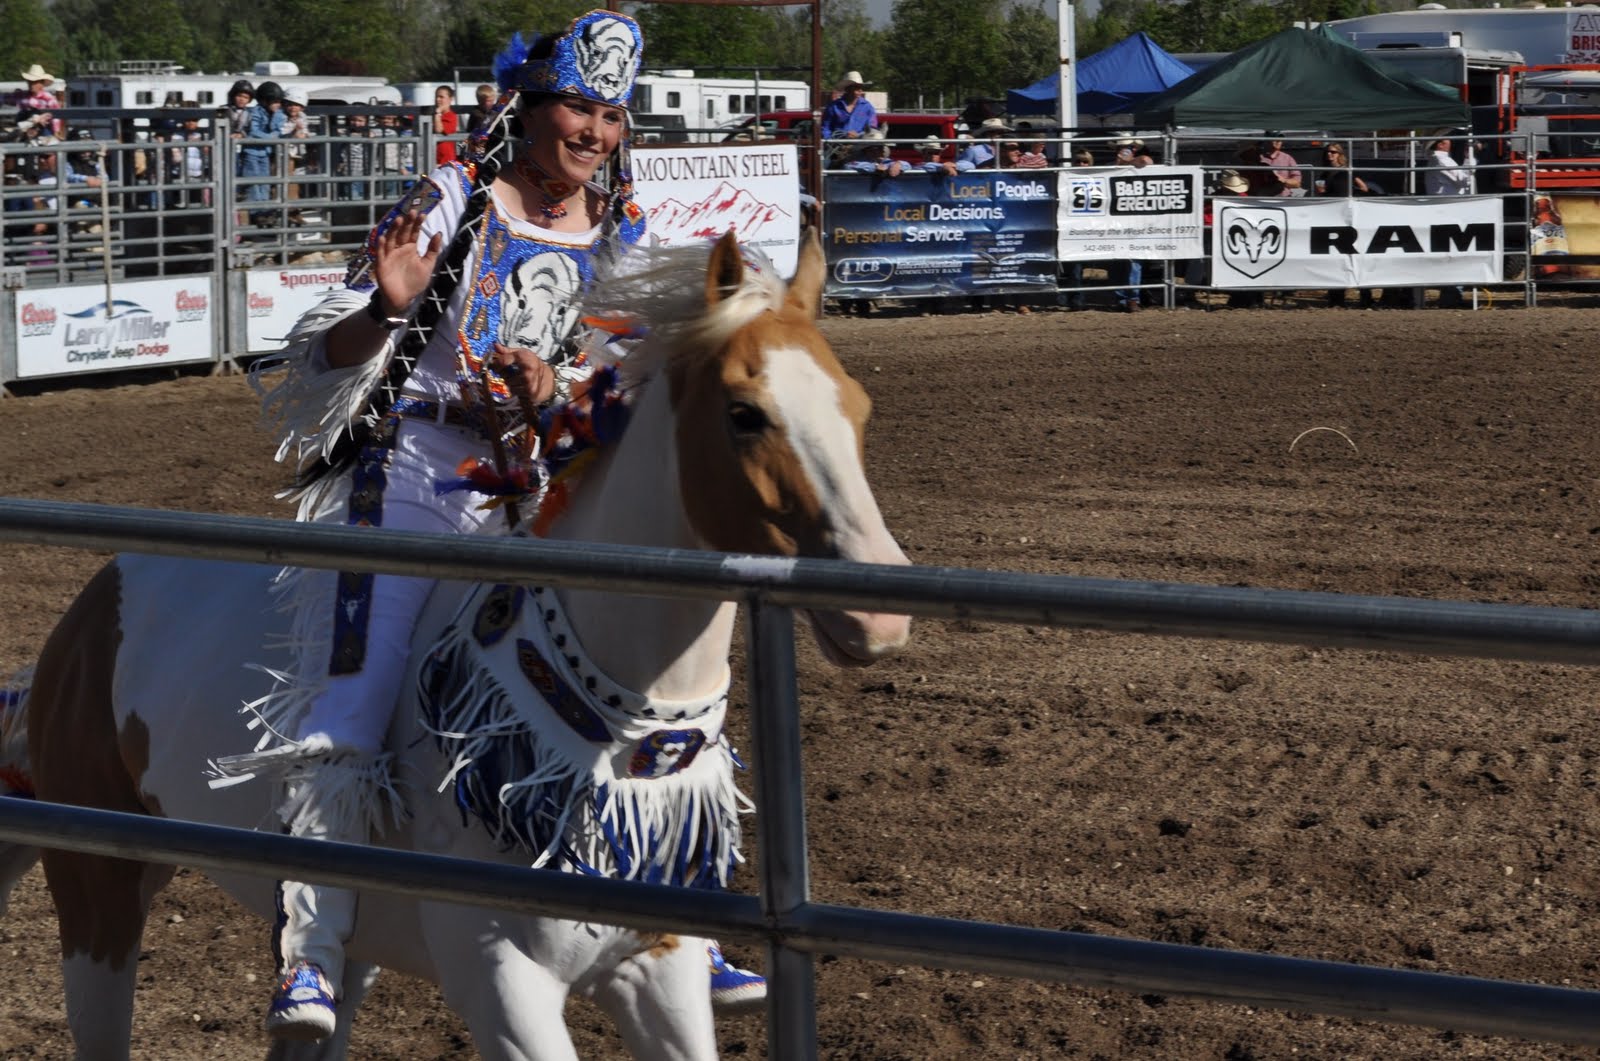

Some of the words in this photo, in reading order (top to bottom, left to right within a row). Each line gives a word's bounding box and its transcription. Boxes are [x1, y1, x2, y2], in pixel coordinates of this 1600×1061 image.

[636, 155, 738, 182] MOUNTAIN
[742, 153, 790, 178] STEEL
[950, 182, 991, 198] Local
[995, 181, 1049, 201] People.
[1115, 180, 1144, 196] B&B
[1146, 179, 1189, 195] STEEL
[884, 205, 926, 221] Local
[929, 204, 1005, 221] Decisions.
[1116, 195, 1186, 212] ERECTORS
[834, 227, 902, 244] Personal
[905, 225, 966, 243] Service.
[1107, 228, 1121, 236] the
[1123, 227, 1145, 235] West
[1147, 226, 1172, 235] Since
[1310, 223, 1495, 255] RAM
[63, 323, 116, 349] Larry
[119, 315, 171, 342] Miller
[67, 348, 110, 364] Chrysler
[111, 346, 135, 359] Jeep
[137, 342, 169, 356] Dodge
